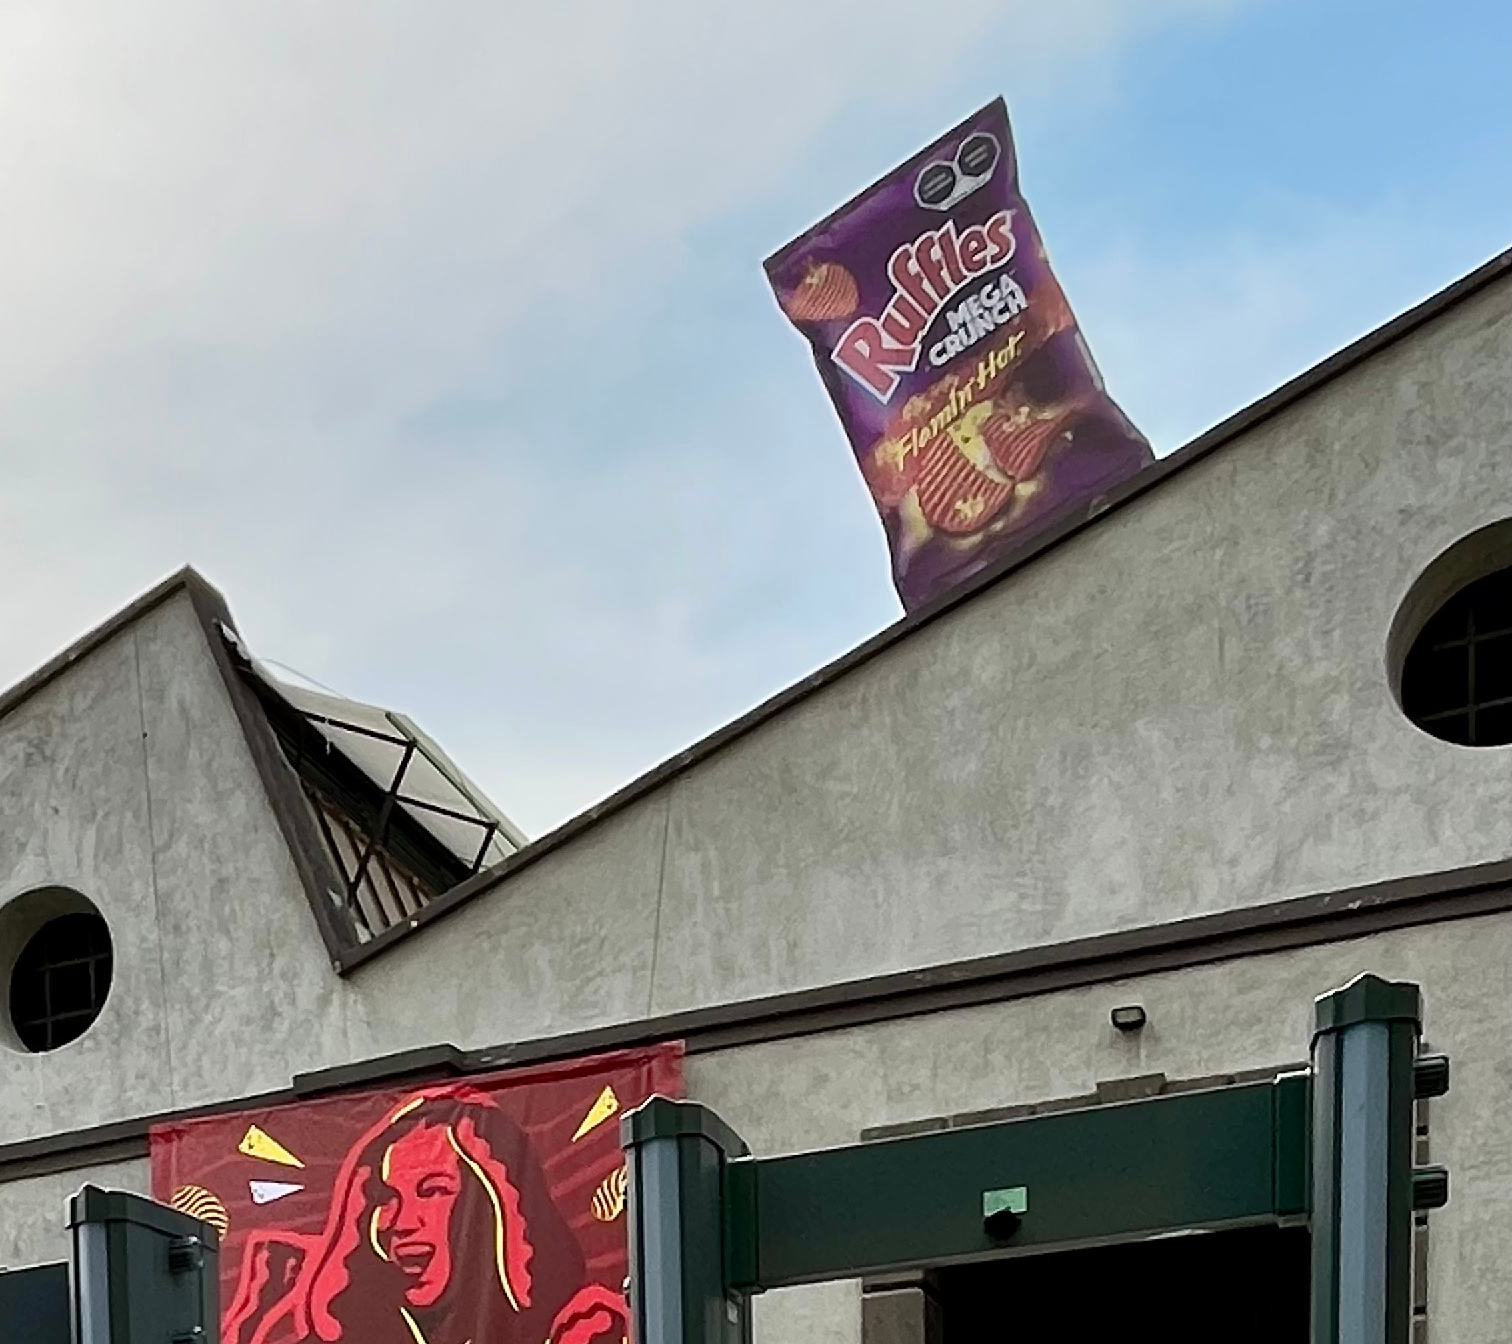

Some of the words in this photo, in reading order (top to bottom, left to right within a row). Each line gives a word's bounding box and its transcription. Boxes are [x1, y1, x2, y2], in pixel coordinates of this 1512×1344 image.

[832, 209, 1017, 404] Ruffles
[928, 284, 1029, 367] CRUNCH
[946, 273, 1023, 331] MEGA
